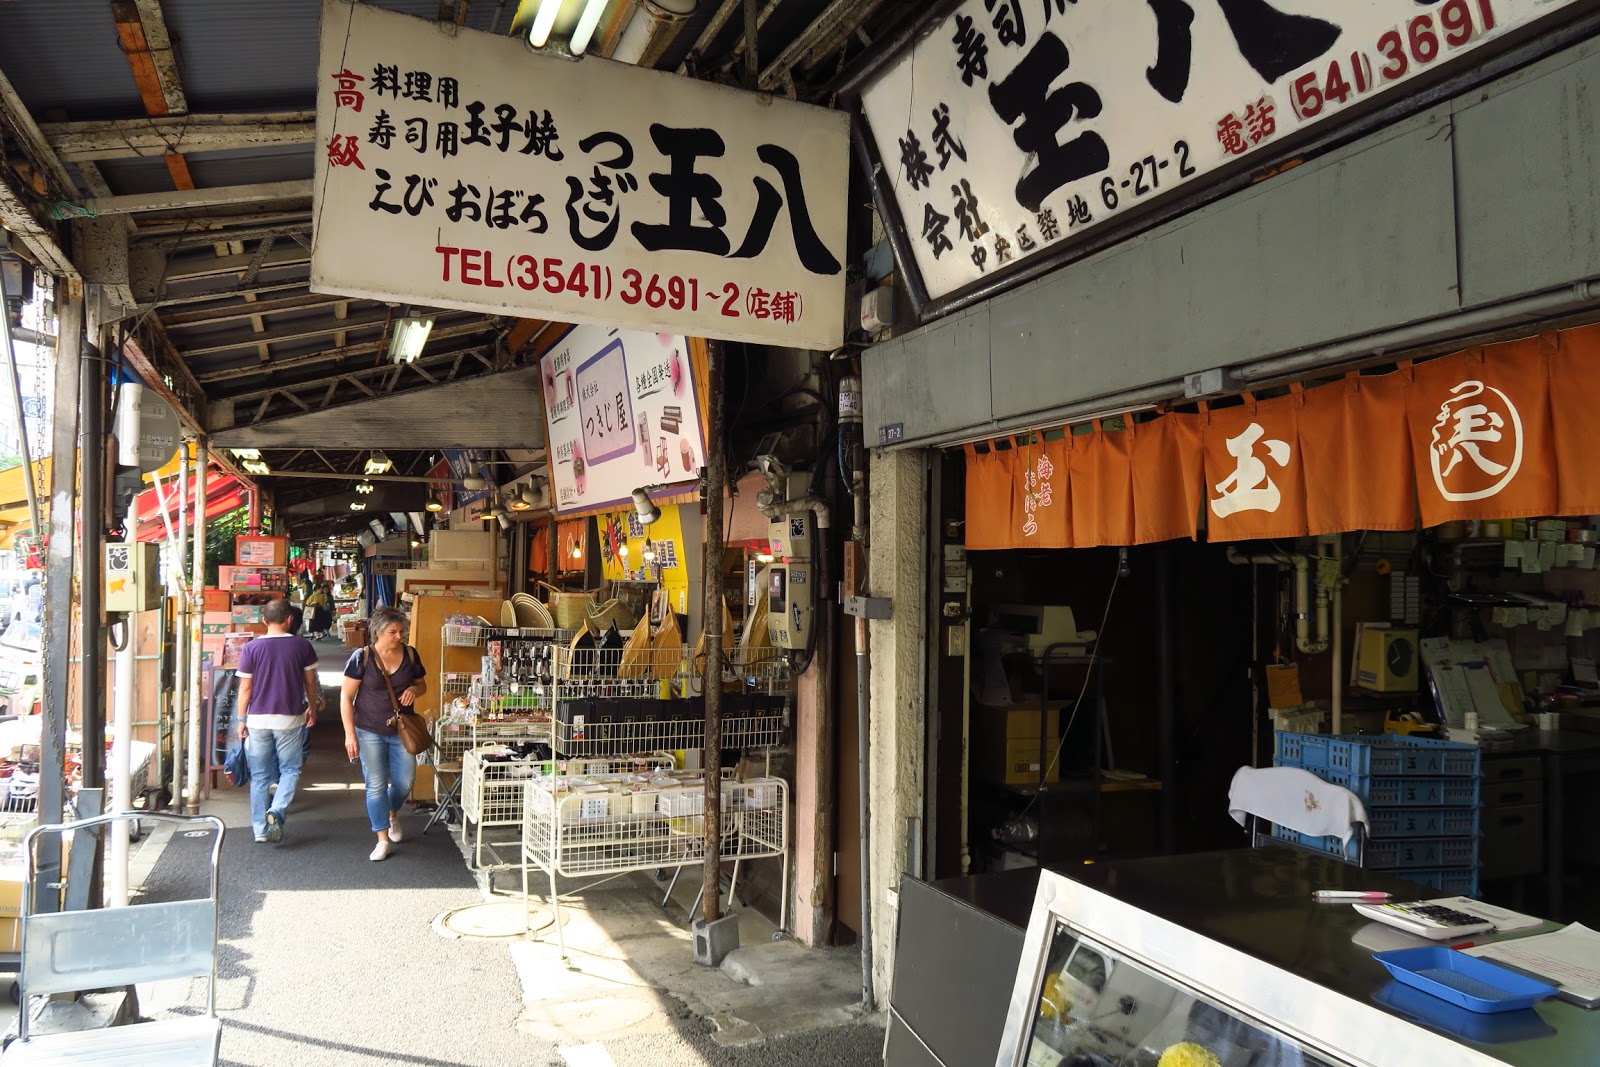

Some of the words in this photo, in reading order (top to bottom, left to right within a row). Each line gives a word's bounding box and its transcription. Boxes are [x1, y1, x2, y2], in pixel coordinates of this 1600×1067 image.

[952, 0, 1078, 87] 寿司
[369, 63, 459, 110] 料理用
[326, 69, 366, 170] 高級
[1216, 98, 1276, 155] 電話
[586, 391, 629, 438] つきじ屋
[887, 427, 901, 439] 27-2
[1210, 422, 1292, 519] 玉
